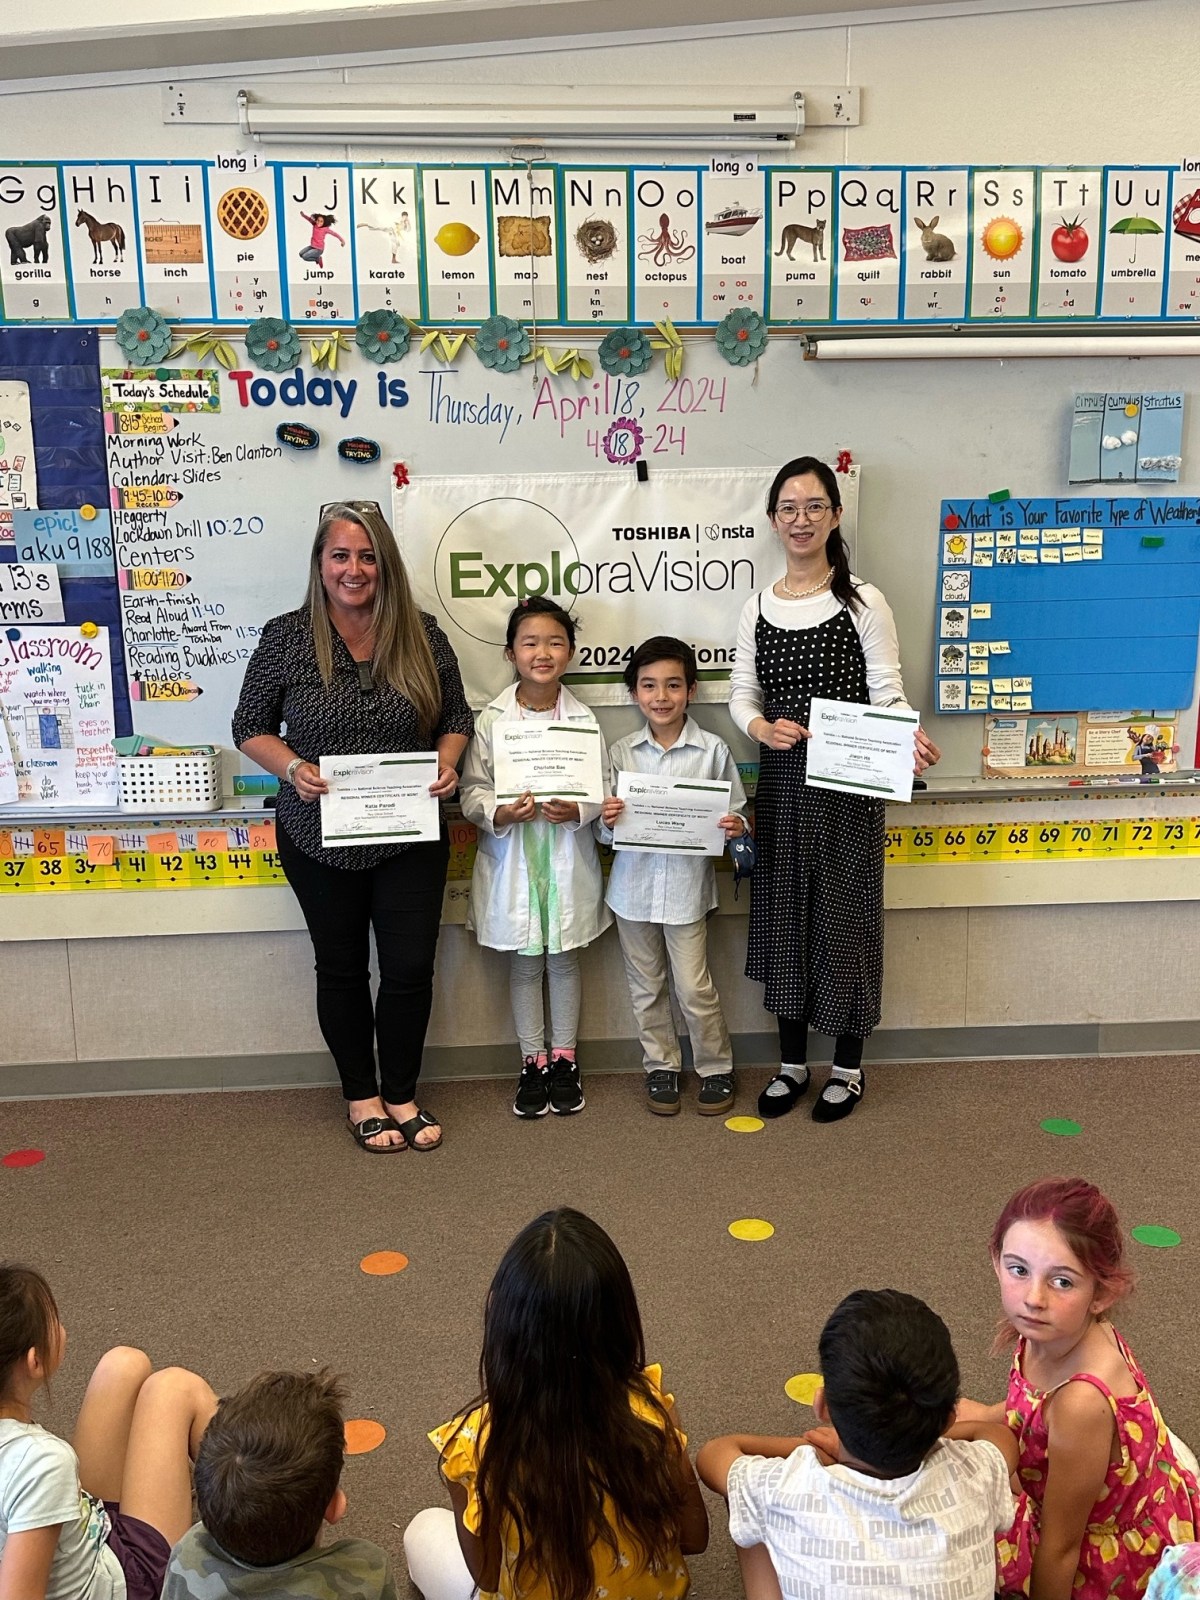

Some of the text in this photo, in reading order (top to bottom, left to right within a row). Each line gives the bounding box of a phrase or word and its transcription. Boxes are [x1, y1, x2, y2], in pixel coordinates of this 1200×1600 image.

[217, 155, 258, 172] long i
[712, 159, 754, 176] long o
[237, 252, 254, 263] pie
[721, 254, 746, 265] boat
[14, 269, 52, 280] gorilla
[90, 268, 122, 278] horse
[164, 268, 188, 277] inch
[304, 270, 334, 281] jump
[369, 270, 405, 280] karate
[441, 270, 475, 280] lemon
[586, 272, 608, 281] nest
[644, 272, 688, 282] octopus
[786, 272, 816, 282] puma
[857, 270, 881, 282] quilt
[920, 269, 952, 279] rabbit
[992, 269, 1010, 278] sun
[1050, 269, 1087, 278] tomato
[1111, 268, 1156, 278] umbrella
[112, 383, 209, 402] Today's Schedule
[228, 367, 410, 418] Today is
[419, 370, 523, 444] Thursday,
[532, 374, 609, 438] April
[656, 376, 727, 414] 2024
[1075, 396, 1105, 408] Cirrus
[1144, 396, 1181, 408] Stratus
[142, 414, 164, 424] School
[108, 432, 205, 456] Morning Work
[110, 450, 164, 469] Author
[212, 446, 233, 464] Ben
[236, 444, 282, 460] Clanton
[183, 468, 222, 484] Slides
[113, 509, 168, 530] Heggerty
[948, 501, 992, 528] What
[1000, 506, 1014, 526] is
[1018, 500, 1048, 526] Your
[1056, 501, 1103, 524] Favorite
[1106, 500, 1130, 526] Type
[1134, 498, 1148, 520] of
[34, 510, 79, 538] epic!
[115, 516, 264, 545] Lockdown Drill 10:20
[612, 524, 755, 541] TOSHIBA nsta
[118, 546, 194, 568] Centers
[948, 556, 968, 566] sunny
[450, 550, 755, 601] ExploraVision
[944, 592, 967, 602] cloudy
[0, 598, 44, 620] rms
[126, 604, 225, 626] Read Aloud 11:40
[182, 622, 208, 634] Award
[210, 620, 232, 631] From
[946, 628, 964, 638] rainy
[184, 634, 223, 644] Toshiba
[128, 646, 237, 672] Reading Buddies
[578, 646, 636, 667] 2024
[27, 662, 62, 676] walking
[144, 668, 192, 682] folders
[940, 666, 964, 675] stormy
[34, 674, 54, 686] only
[942, 701, 961, 710] snowy
[80, 727, 111, 737] teacher
[884, 825, 1185, 848] 64 65 66 67 68 69 70 71 72 73
[38, 842, 60, 856] 65
[92, 842, 112, 857] 70
[4, 852, 282, 877] 37 38 39 41 42 43 44 45
[830, 1564, 900, 1586] PUMA
